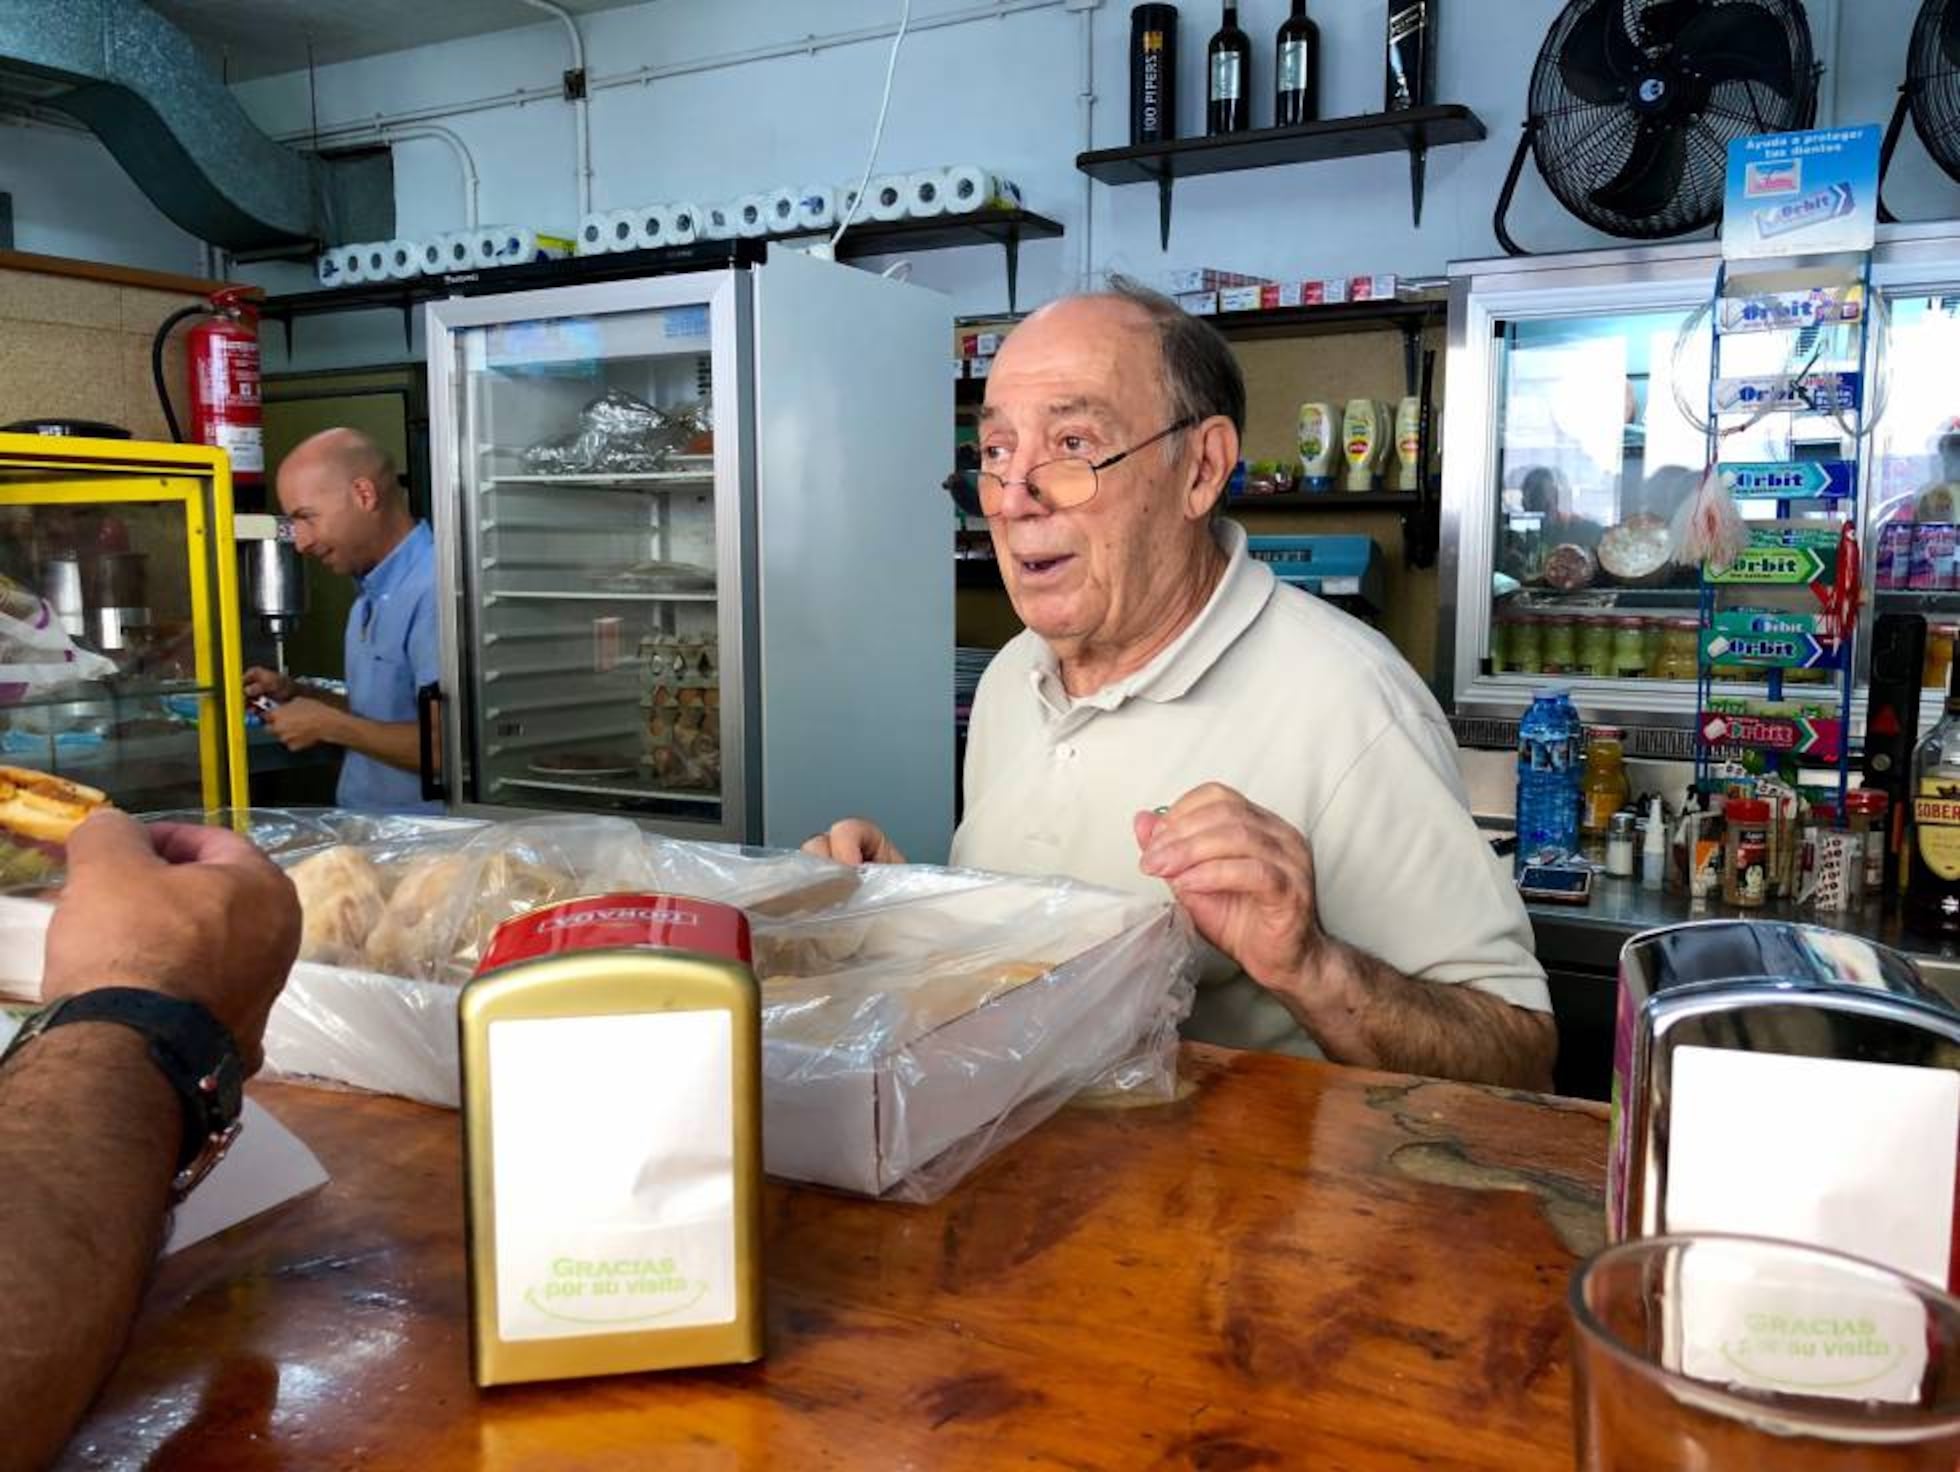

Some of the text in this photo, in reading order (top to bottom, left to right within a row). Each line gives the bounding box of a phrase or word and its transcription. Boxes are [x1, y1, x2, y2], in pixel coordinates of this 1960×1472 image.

[1144, 54, 1158, 104] PIPERS
[1745, 136, 1787, 151] Ayuda
[1802, 130, 1864, 146] proteger
[1764, 144, 1842, 159] tus dientes
[1781, 195, 1830, 218] Orbit
[1742, 301, 1812, 321] Orbit
[1735, 472, 1803, 488] Orbit
[1732, 557, 1797, 573] Orbit
[1728, 638, 1796, 656] Orbit
[552, 1257, 675, 1277] GRACIAS
[545, 1275, 687, 1300] por su visita
[1745, 1312, 1876, 1337] GRACIAS
[1824, 1338, 1889, 1358] visita
